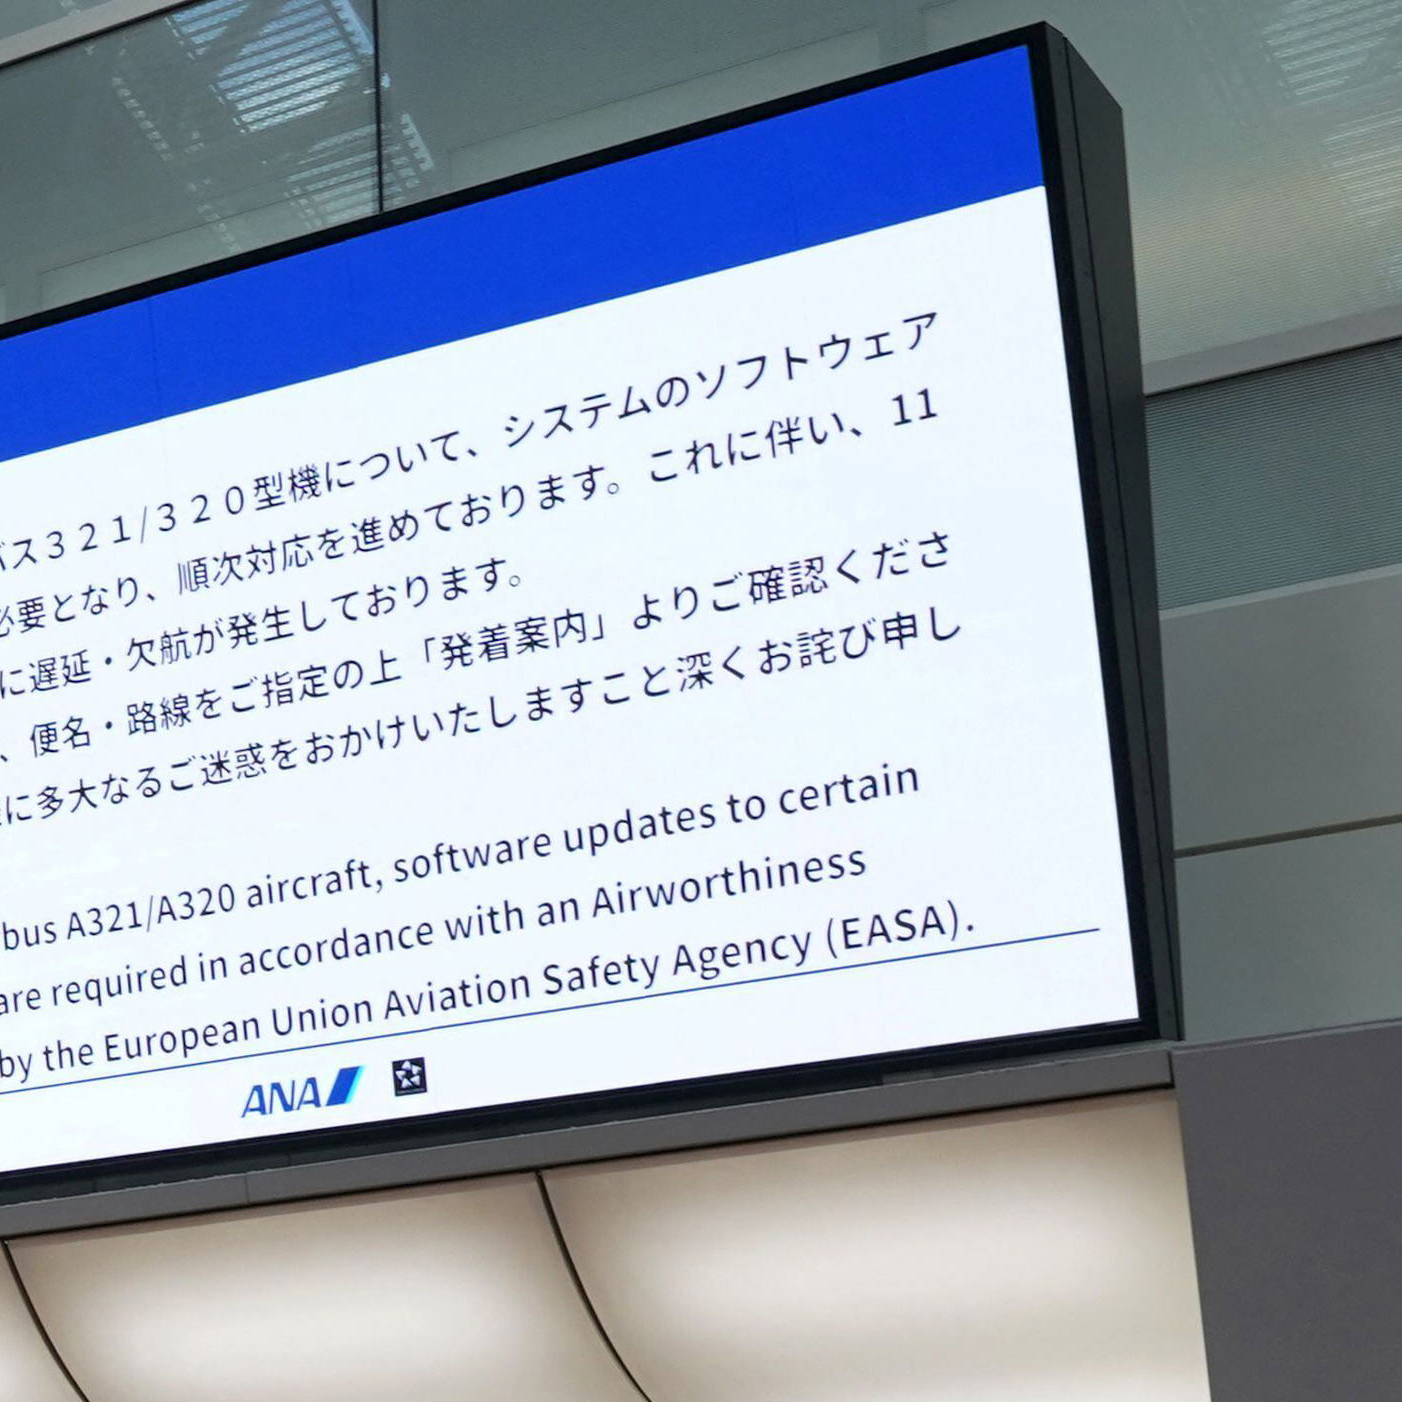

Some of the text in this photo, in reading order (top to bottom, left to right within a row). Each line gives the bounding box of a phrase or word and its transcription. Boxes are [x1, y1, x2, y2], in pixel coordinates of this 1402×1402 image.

[52, 954, 188, 1007] required
[198, 952, 228, 982] in
[239, 922, 433, 976] accordance
[444, 899, 524, 941] with
[537, 897, 580, 927] an
[592, 850, 866, 918] Airworthiness
[67, 883, 235, 940] A321/A320
[247, 858, 383, 908] aircraft,
[394, 833, 551, 883] software
[563, 803, 716, 857] updates
[726, 794, 766, 824] to
[779, 762, 919, 815] certain
[42, 1039, 94, 1072] the
[104, 1017, 260, 1062] European
[271, 998, 373, 1037] Union
[384, 973, 530, 1020] Aviation
[543, 954, 660, 996] Safety
[673, 931, 811, 981] Agency
[826, 899, 974, 959] (EASA).
[241, 1077, 323, 1118] ANA
